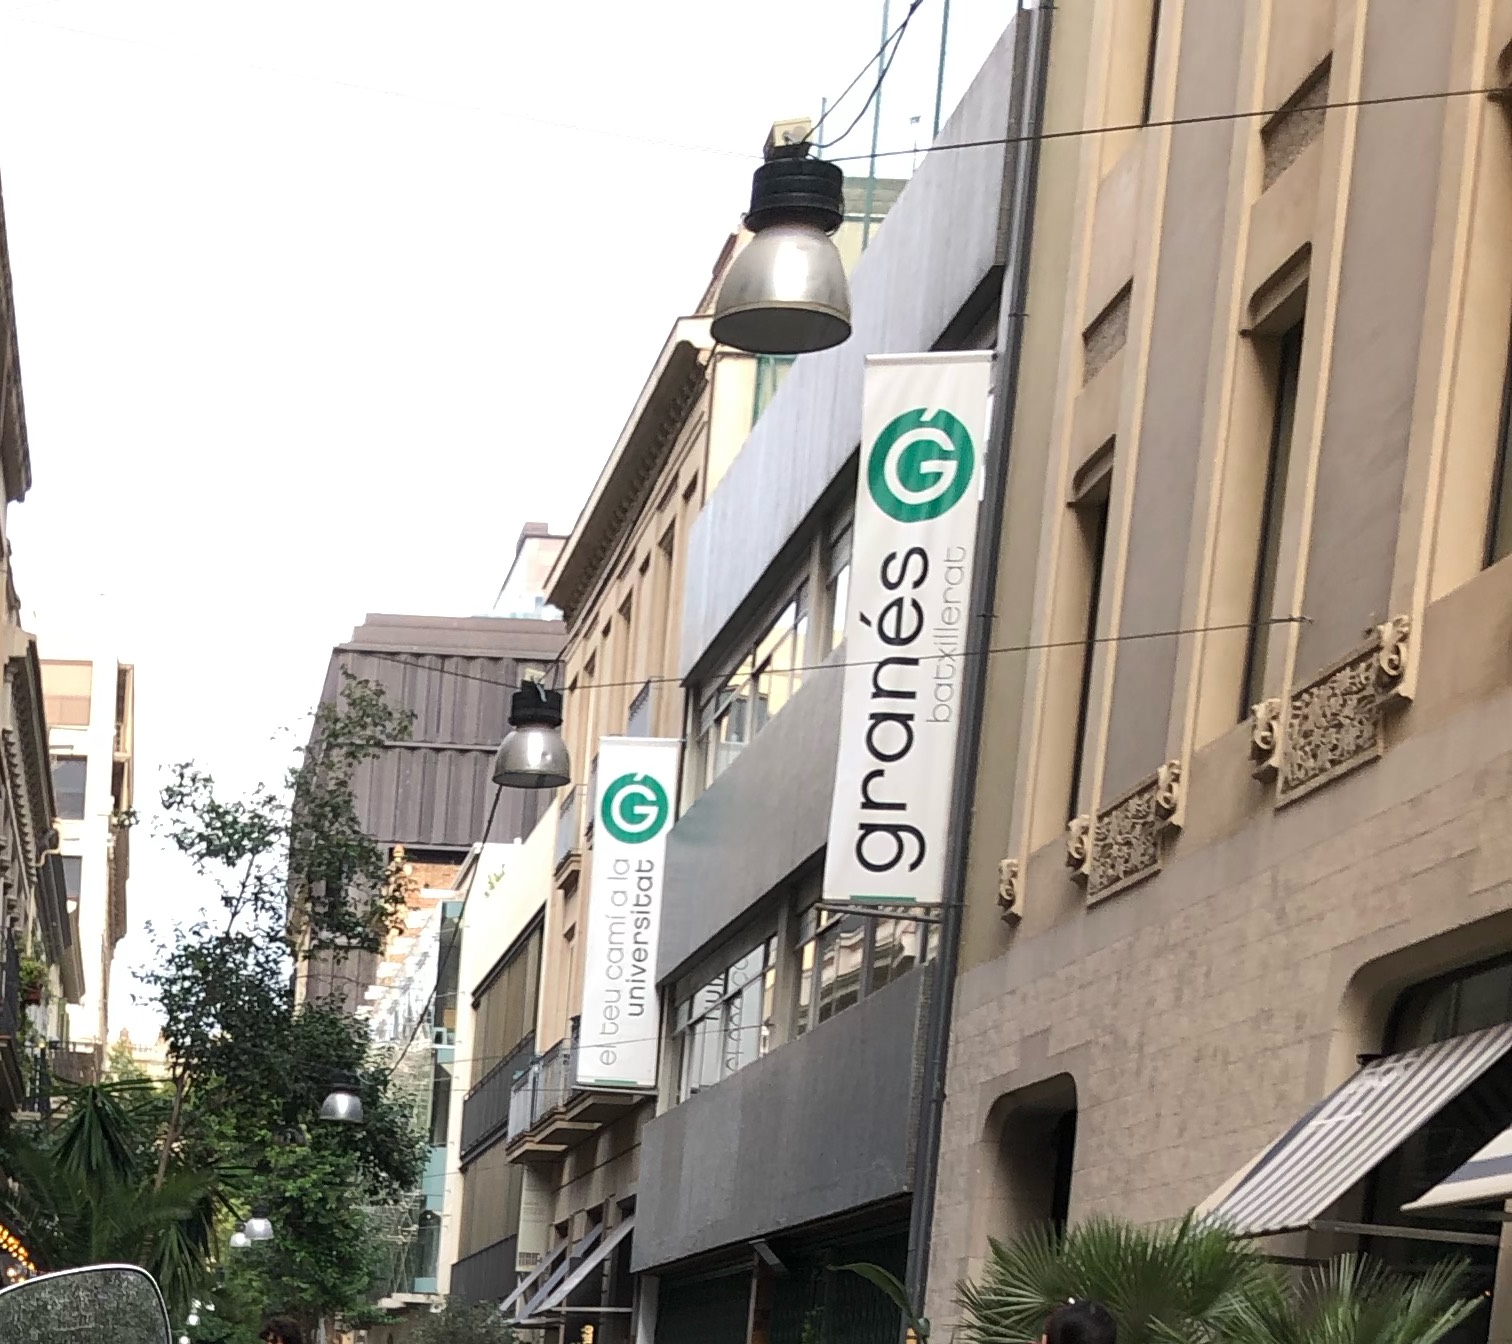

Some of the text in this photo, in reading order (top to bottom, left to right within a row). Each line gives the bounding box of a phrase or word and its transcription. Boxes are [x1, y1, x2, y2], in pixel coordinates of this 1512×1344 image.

[855, 546, 931, 873] granés
[925, 545, 967, 724] batxillerat
[596, 858, 630, 1066] el teu camí a la
[626, 859, 655, 1017] universitat
